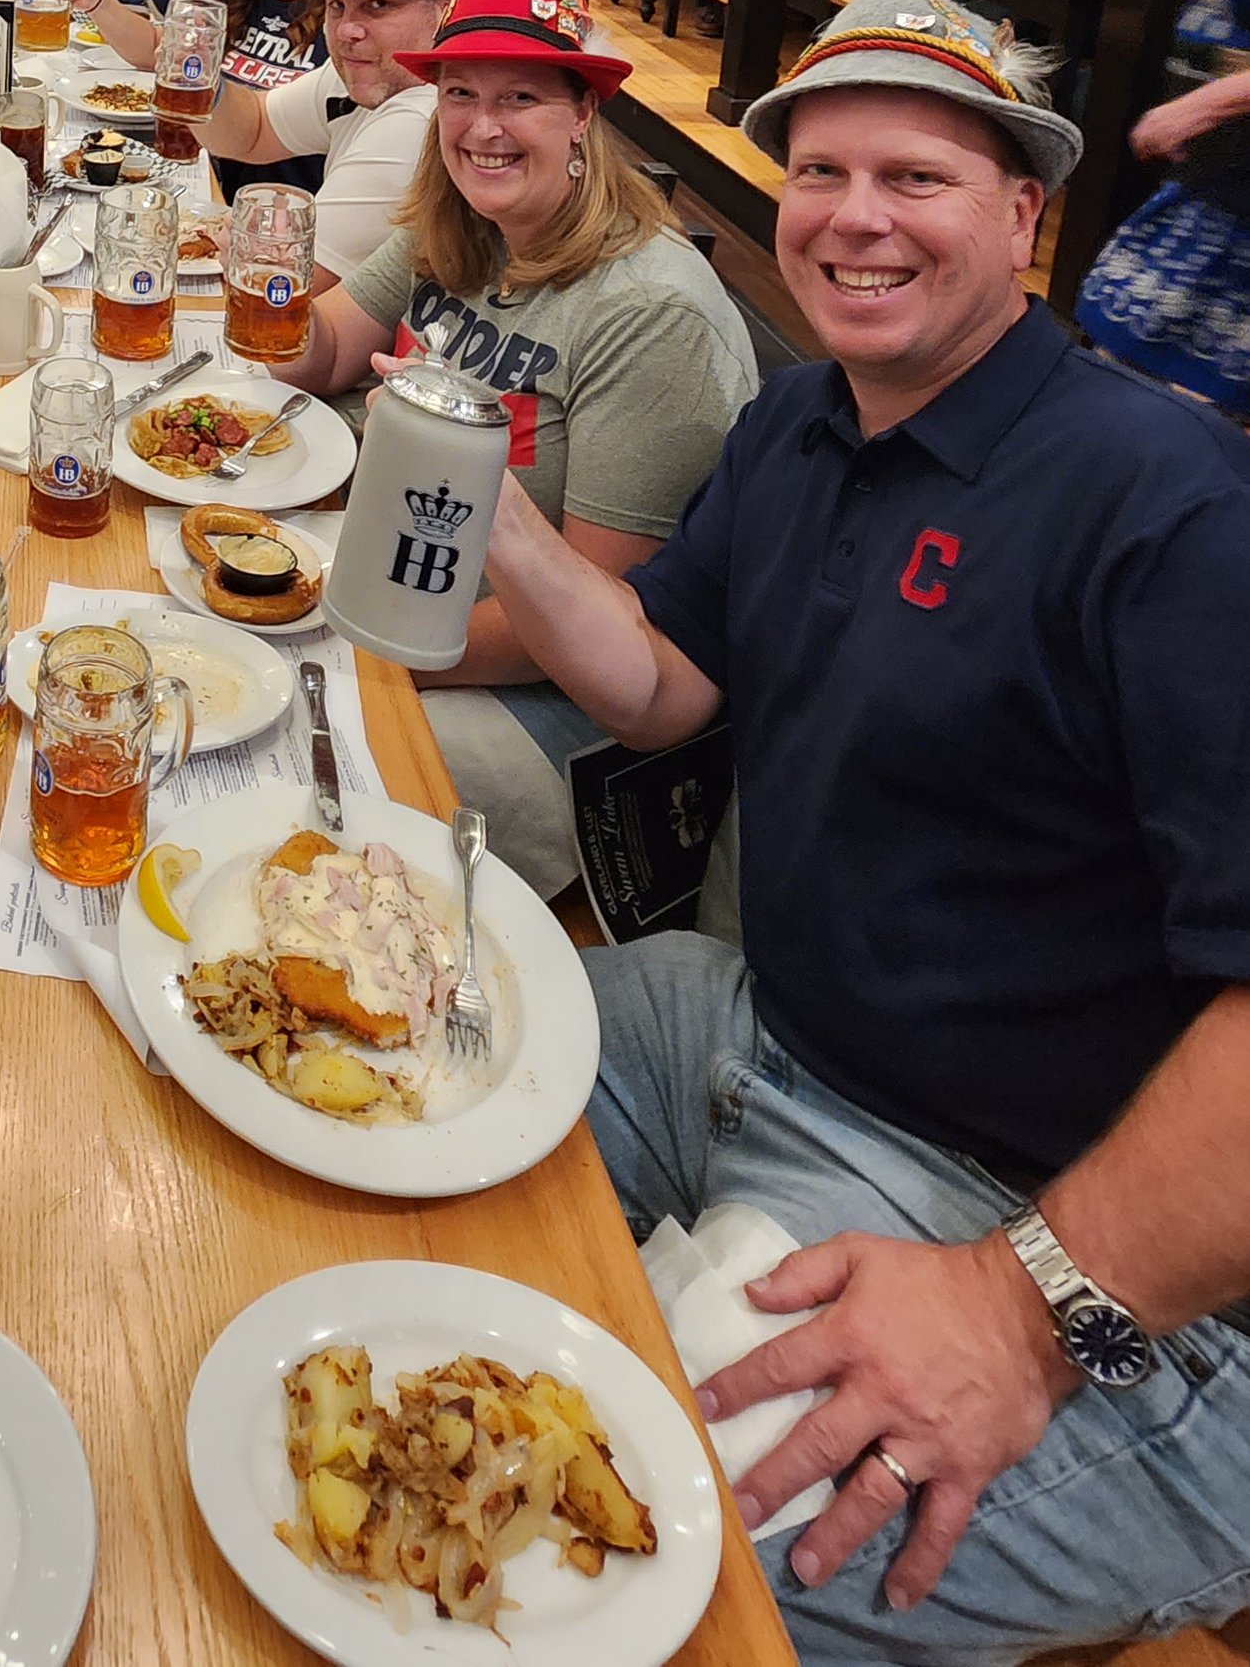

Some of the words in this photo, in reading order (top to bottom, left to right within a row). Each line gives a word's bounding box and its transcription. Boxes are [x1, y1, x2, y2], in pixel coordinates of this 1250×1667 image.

[271, 289, 288, 302] HB
[59, 468, 75, 481] HB
[386, 530, 460, 594] HB
[900, 528, 960, 609] C
[593, 843, 617, 915] CLEVELAND
